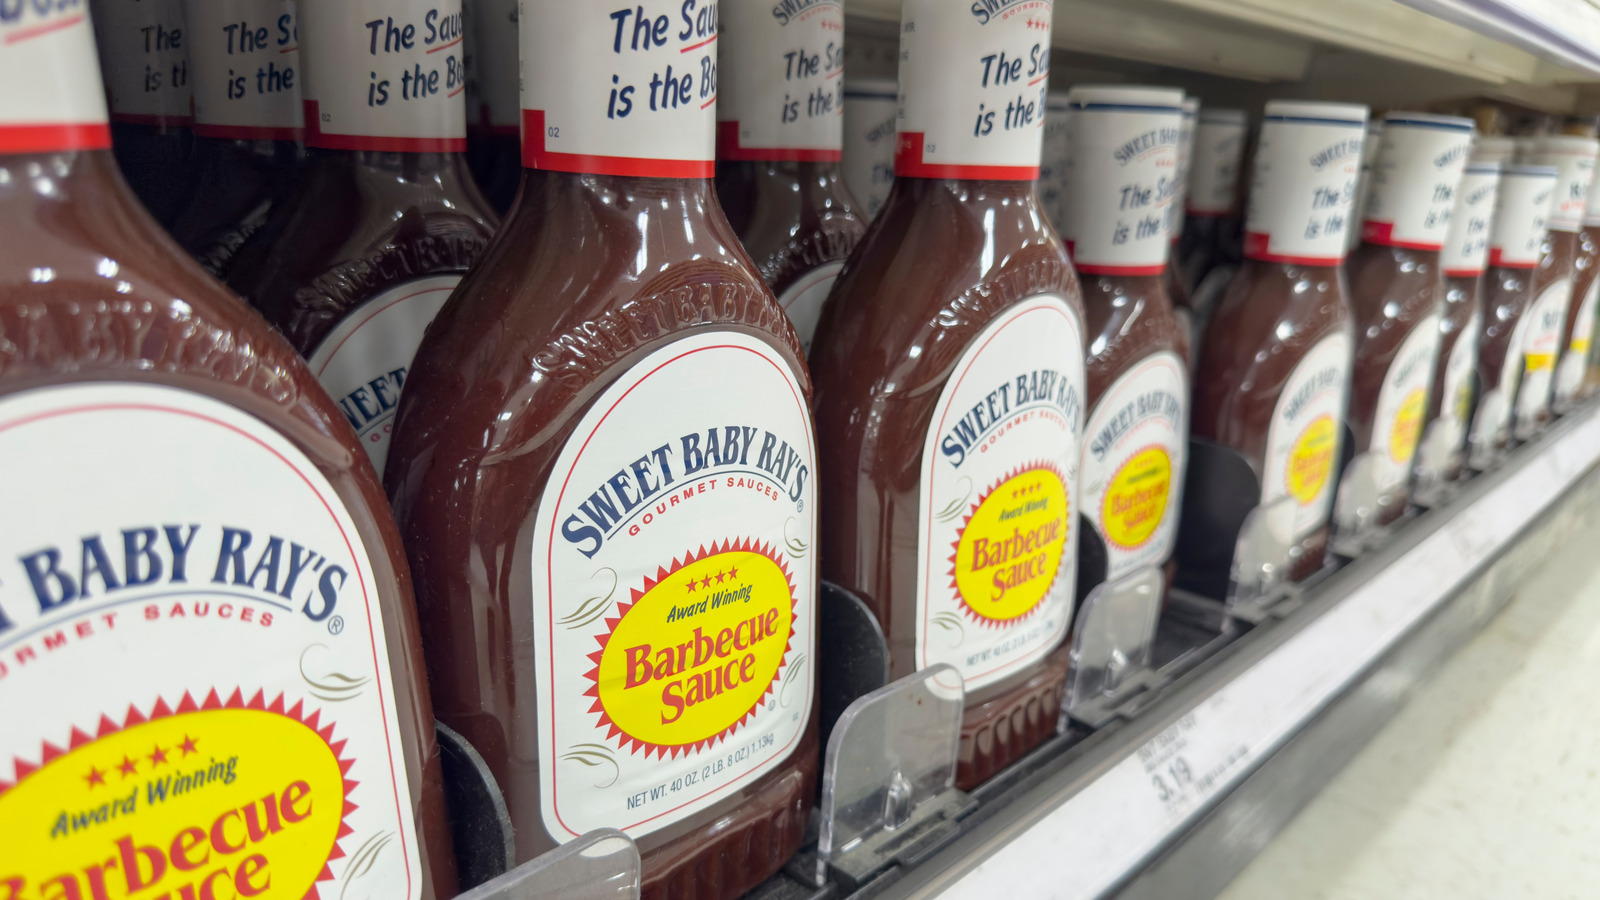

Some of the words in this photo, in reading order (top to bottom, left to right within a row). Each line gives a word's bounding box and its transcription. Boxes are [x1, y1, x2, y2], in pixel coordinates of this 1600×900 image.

[141, 24, 183, 53] The
[223, 21, 269, 55] The
[365, 17, 416, 55] The
[609, 6, 669, 53] The
[145, 65, 162, 92] is
[228, 69, 246, 100] is
[256, 61, 294, 94] the
[368, 71, 390, 107] is
[401, 63, 439, 101] the
[784, 48, 820, 81] The
[981, 51, 1023, 88] The
[607, 74, 635, 119] is
[649, 64, 693, 111] the
[782, 94, 800, 124] is
[807, 85, 833, 118] the
[322, 113, 331, 123] 02
[548, 126, 560, 138] 02
[974, 103, 995, 137] is
[1004, 95, 1034, 131] the
[925, 144, 936, 154] 02
[1114, 130, 1157, 168] SWEET
[1119, 184, 1151, 211] The
[1312, 187, 1339, 211] The
[1112, 219, 1130, 247] is
[1136, 214, 1161, 242] the
[941, 382, 1011, 470] SWEET
[1015, 368, 1059, 408] BABY
[980, 411, 1035, 454] GOURMET
[1090, 401, 1135, 463] SWEET
[561, 442, 675, 560] SWEET
[679, 425, 758, 477] BABY
[755, 430, 809, 503] RAY'S
[628, 479, 718, 537] GOURMET
[726, 476, 779, 502] SAUCES
[998, 503, 1023, 522] Award
[970, 516, 1062, 573] Barbecue
[18, 523, 202, 617] BABY
[209, 524, 350, 623] RAY'S
[990, 551, 1048, 602] Sauce
[143, 600, 275, 629] SAUCES
[666, 595, 710, 624] Award
[711, 583, 754, 608] Winning
[623, 606, 780, 691] Barbecue
[660, 652, 757, 726] Sauce
[627, 791, 648, 810] NET
[650, 783, 668, 804] WT.
[670, 778, 683, 793] 40
[684, 770, 700, 790] OZ.
[701, 763, 711, 784] (2
[712, 756, 726, 776] LB.
[727, 753, 733, 767] 8
[734, 745, 750, 768] OZ.)
[751, 733, 774, 755] 1.13kg
[1151, 755, 1193, 804] 3.19
[50, 790, 138, 842] Award
[146, 753, 239, 805] Winning
